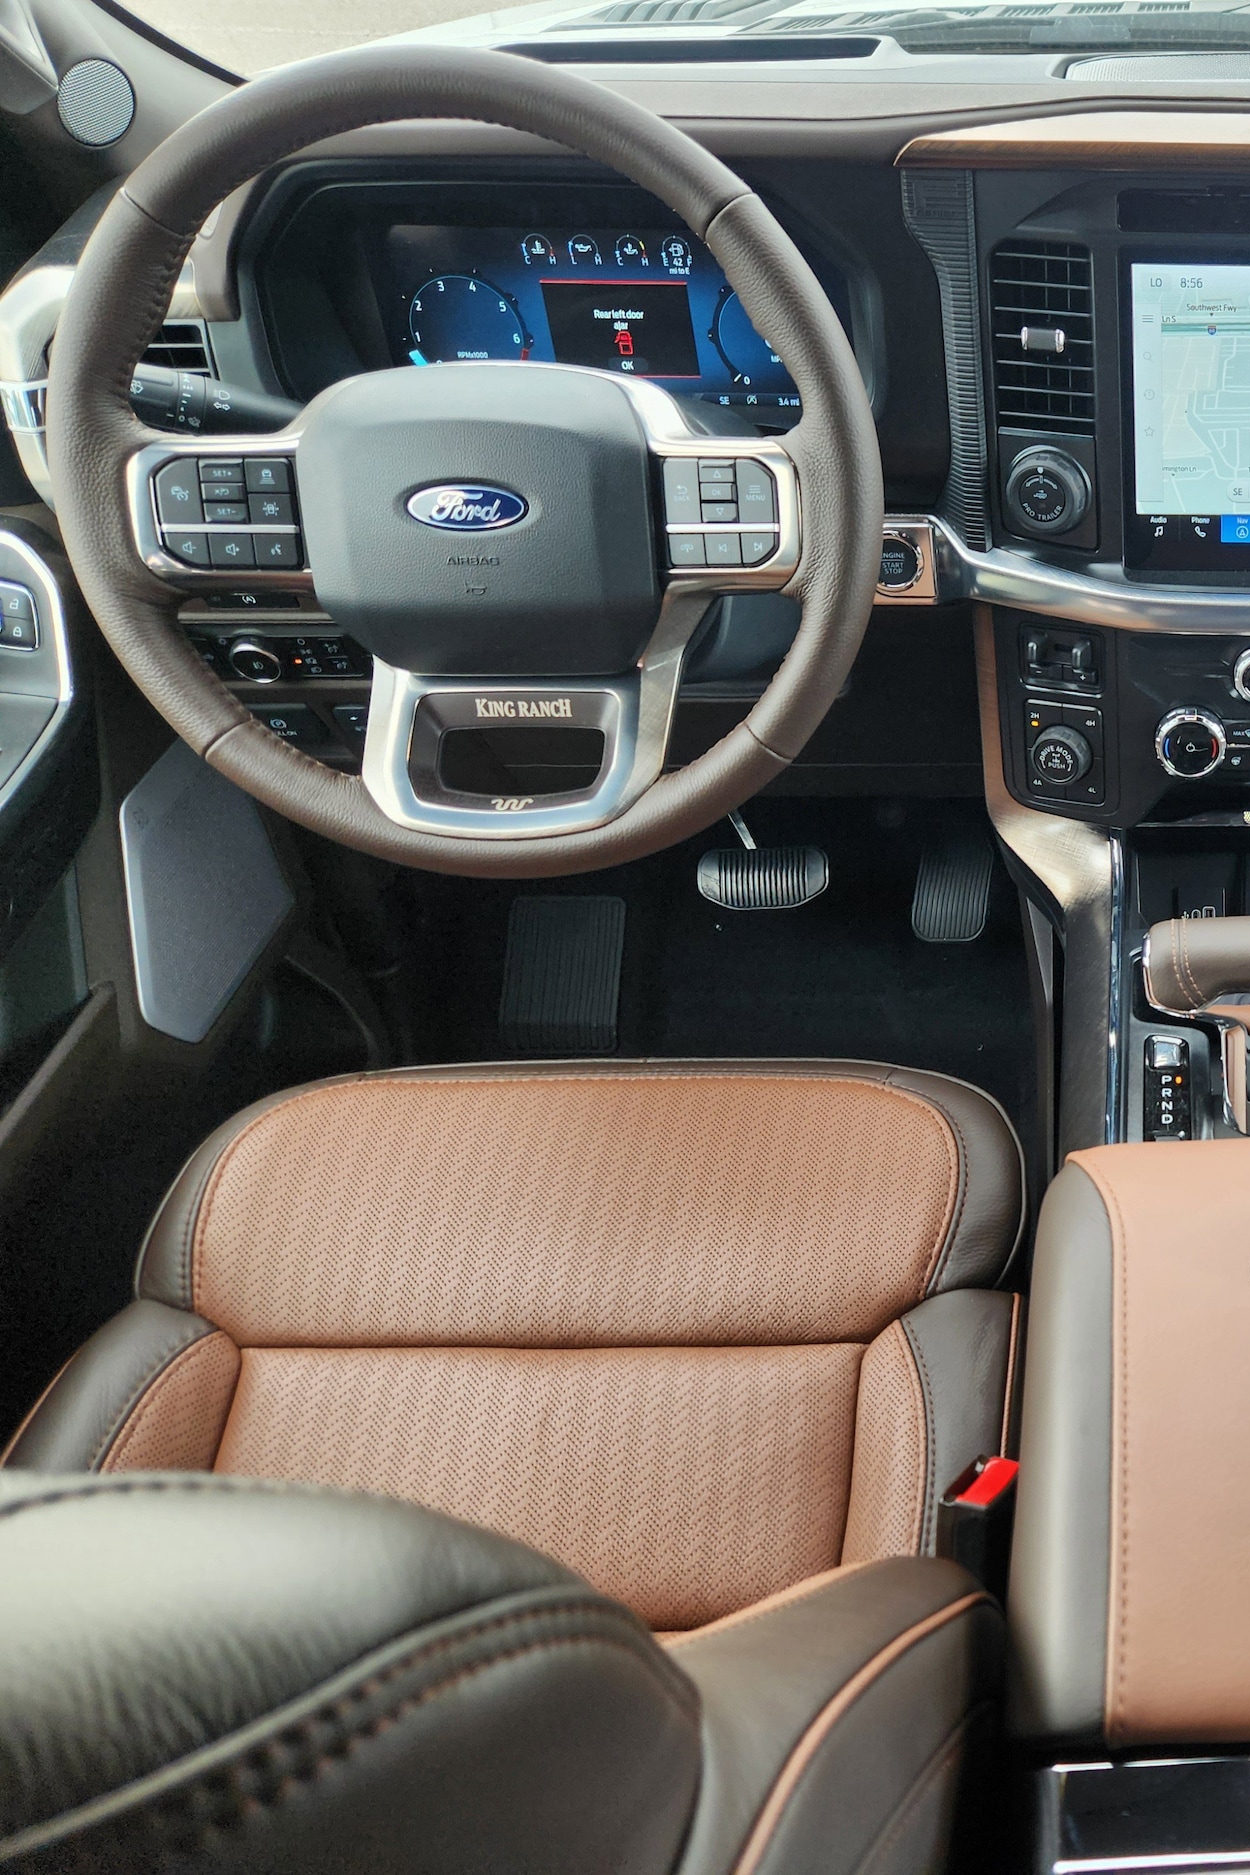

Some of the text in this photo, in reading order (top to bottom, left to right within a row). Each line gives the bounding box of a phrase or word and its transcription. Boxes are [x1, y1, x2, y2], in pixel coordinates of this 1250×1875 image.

[550, 256, 557, 265] H
[642, 258, 649, 266] H
[673, 258, 683, 266] 42
[437, 281, 445, 292] 3
[469, 281, 476, 292] 4
[1180, 278, 1203, 289] 8:56
[415, 300, 422, 311] 2
[499, 301, 507, 312] 5
[1186, 304, 1238, 313] Southwest Fwy
[593, 310, 644, 319] Rear left door
[614, 322, 628, 330] ajar
[415, 331, 421, 342] 1
[512, 333, 521, 344] 6
[770, 355, 782, 363] MP
[621, 361, 635, 370] OK
[719, 396, 730, 405] SE
[1233, 488, 1243, 496] SE
[428, 490, 501, 522] Ford
[1022, 503, 1063, 521] PRO TRAILER
[1150, 516, 1167, 524] Audio
[1191, 516, 1210, 524] Phone
[446, 556, 499, 566] AIRBAG
[475, 698, 573, 718] KING RANCH
[1039, 745, 1073, 764] DRIVE MODE
[1161, 1075, 1172, 1085] P
[1161, 1088, 1172, 1097] R
[1161, 1101, 1173, 1110] N
[1161, 1114, 1173, 1124] D
